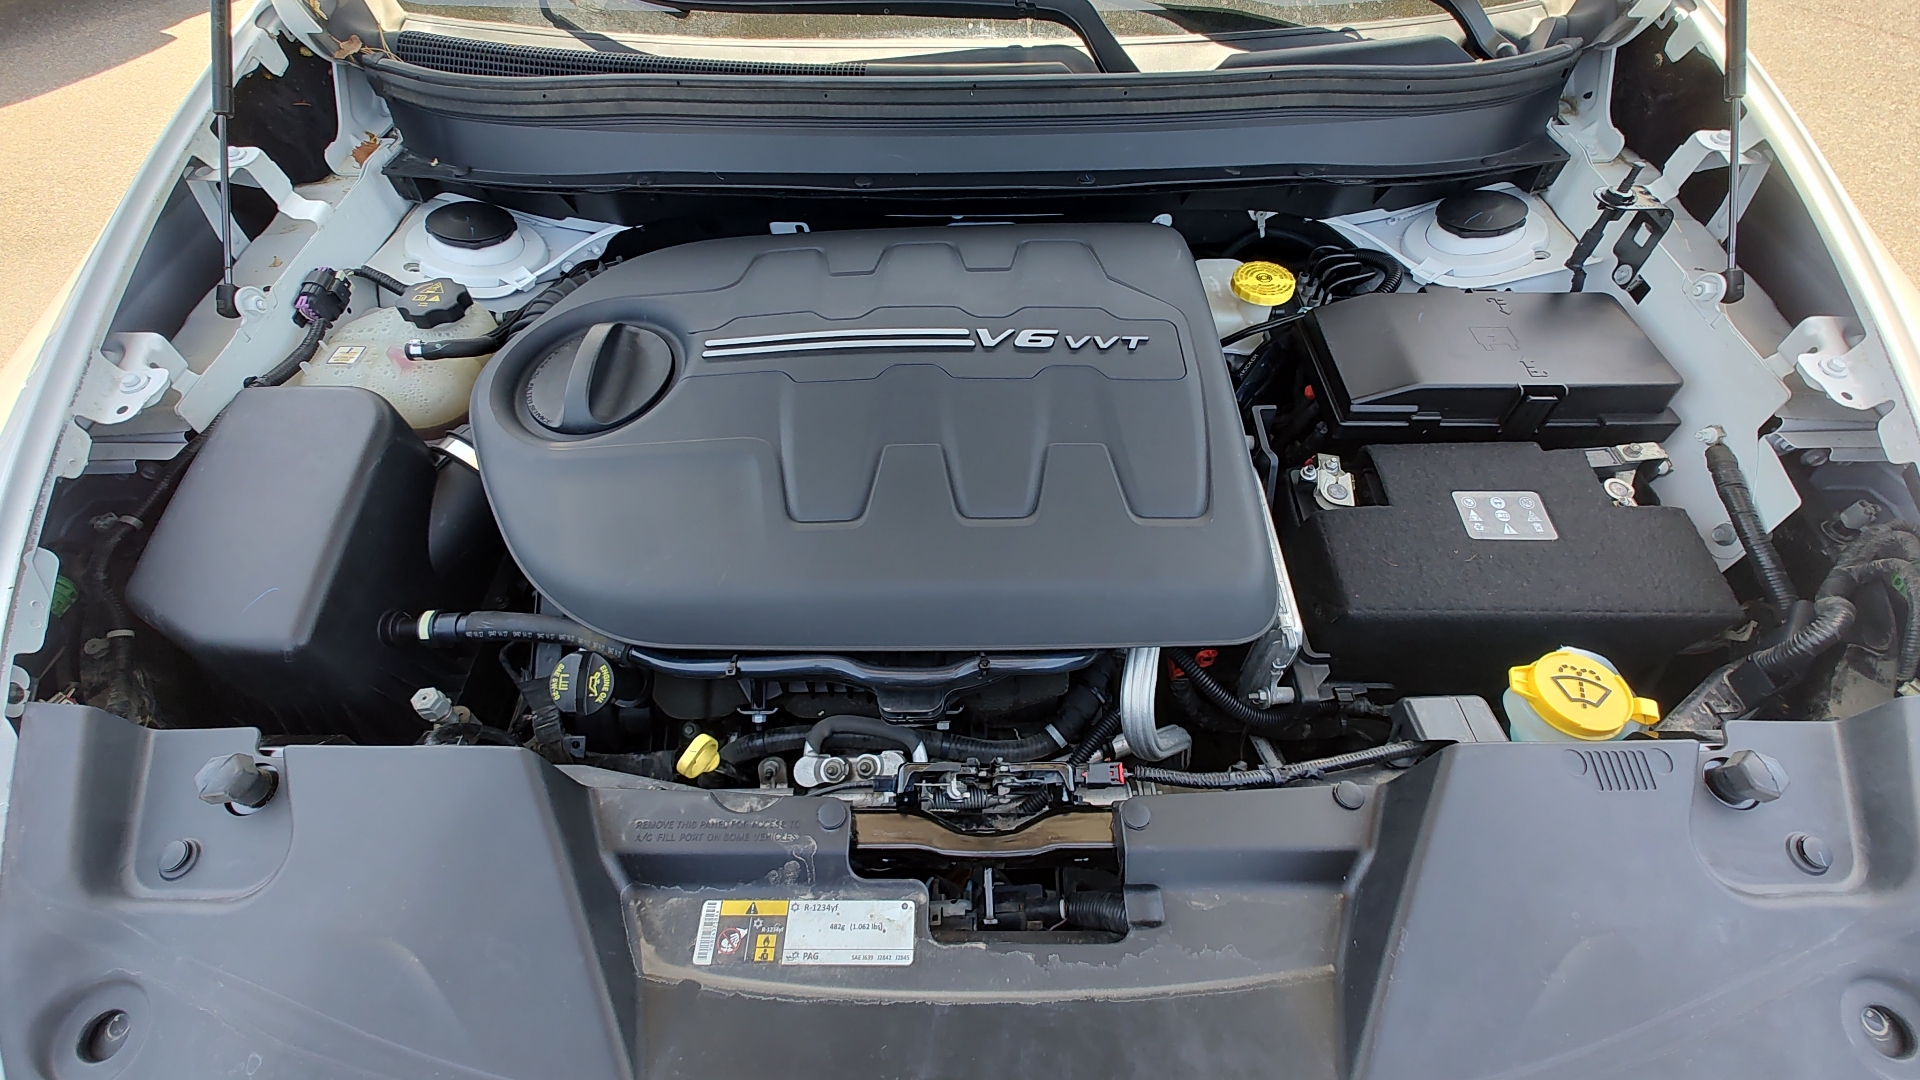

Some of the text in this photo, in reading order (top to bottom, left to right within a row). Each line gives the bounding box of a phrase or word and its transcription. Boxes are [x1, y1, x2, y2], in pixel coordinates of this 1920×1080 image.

[976, 328, 1149, 350] V6 VVT
[595, 664, 610, 703] ENGINE OIL
[635, 820, 674, 829] REMOVE
[677, 820, 697, 829] THIS
[635, 832, 653, 842] A/C
[657, 833, 675, 842] FILL
[679, 833, 704, 842] PORT
[707, 833, 721, 842] ON
[804, 903, 839, 912] R-1234yf
[830, 923, 845, 931] 482g
[850, 922, 870, 931] (1.062
[803, 952, 819, 960] PAG
